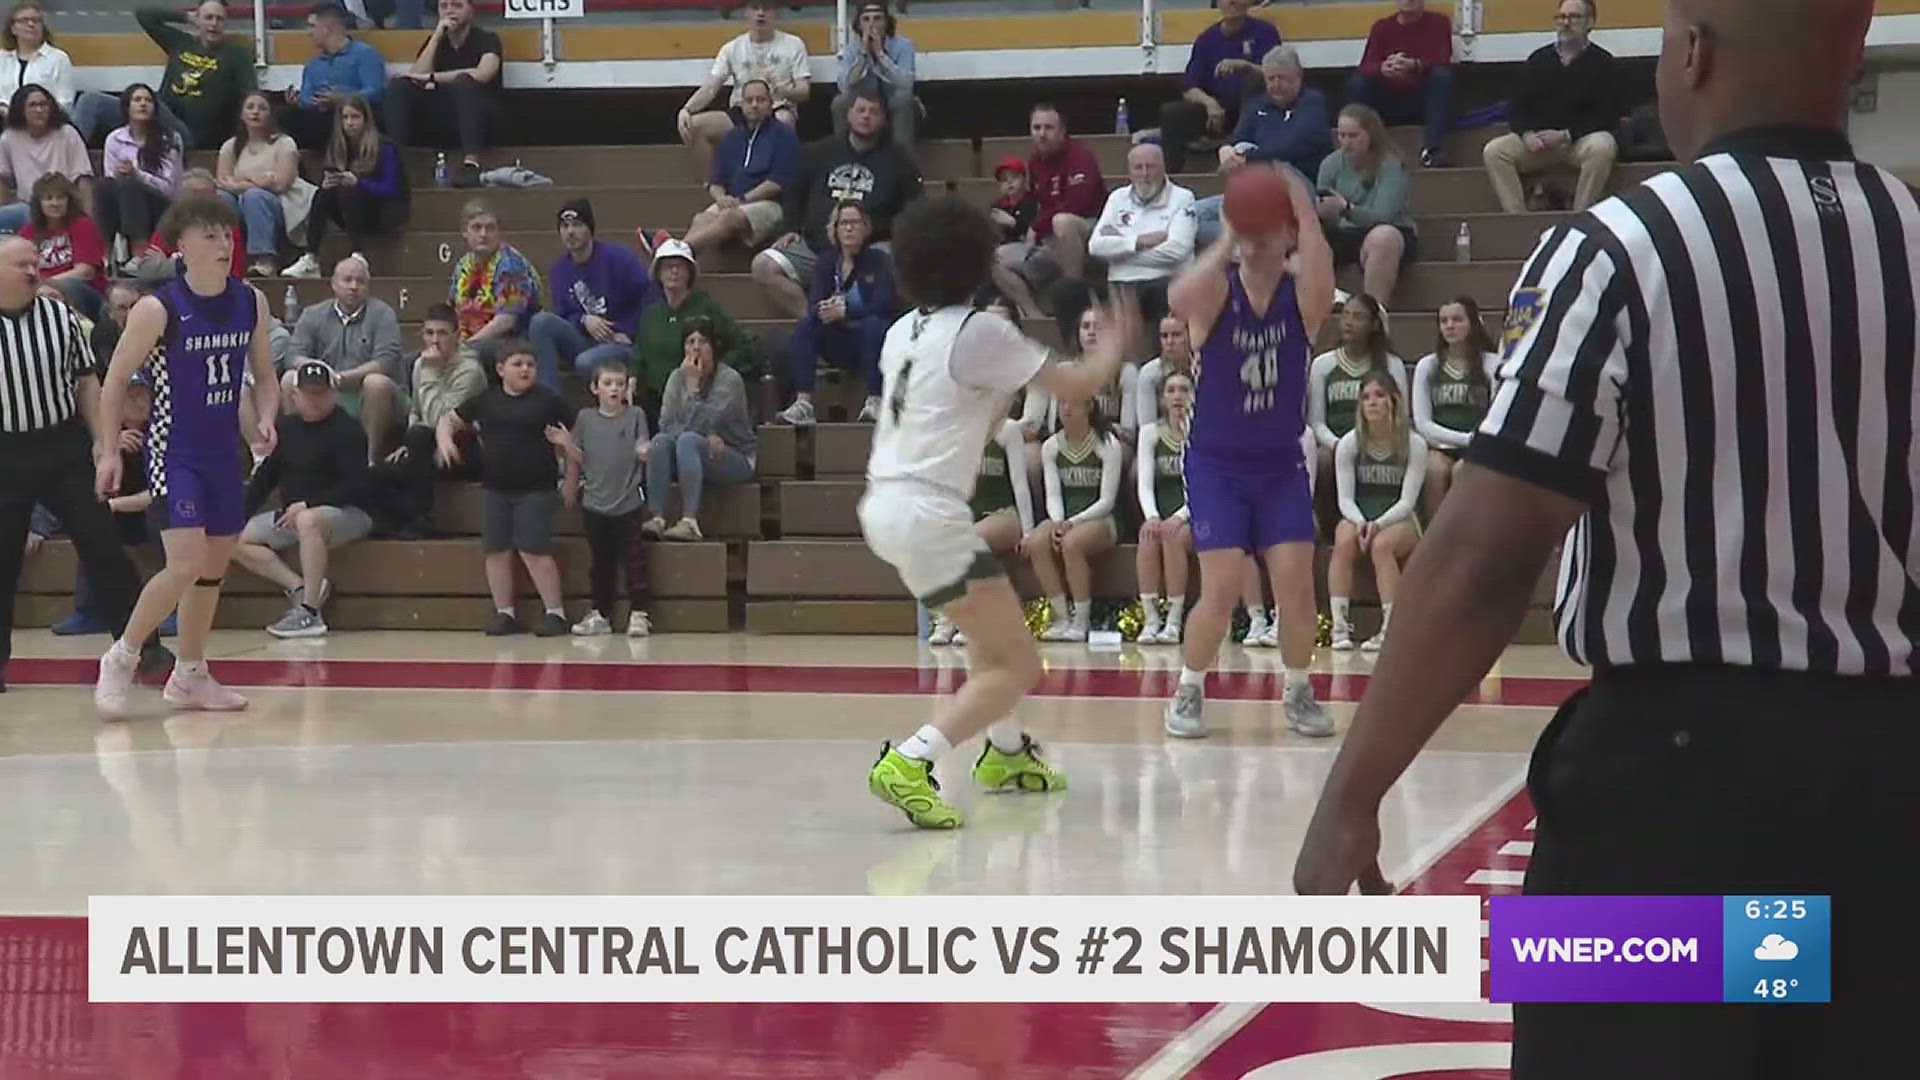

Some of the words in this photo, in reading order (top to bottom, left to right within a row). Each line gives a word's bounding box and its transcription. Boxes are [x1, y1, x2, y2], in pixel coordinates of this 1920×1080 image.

[439, 243, 451, 263] G
[399, 288, 408, 309] F
[205, 353, 231, 385] 11
